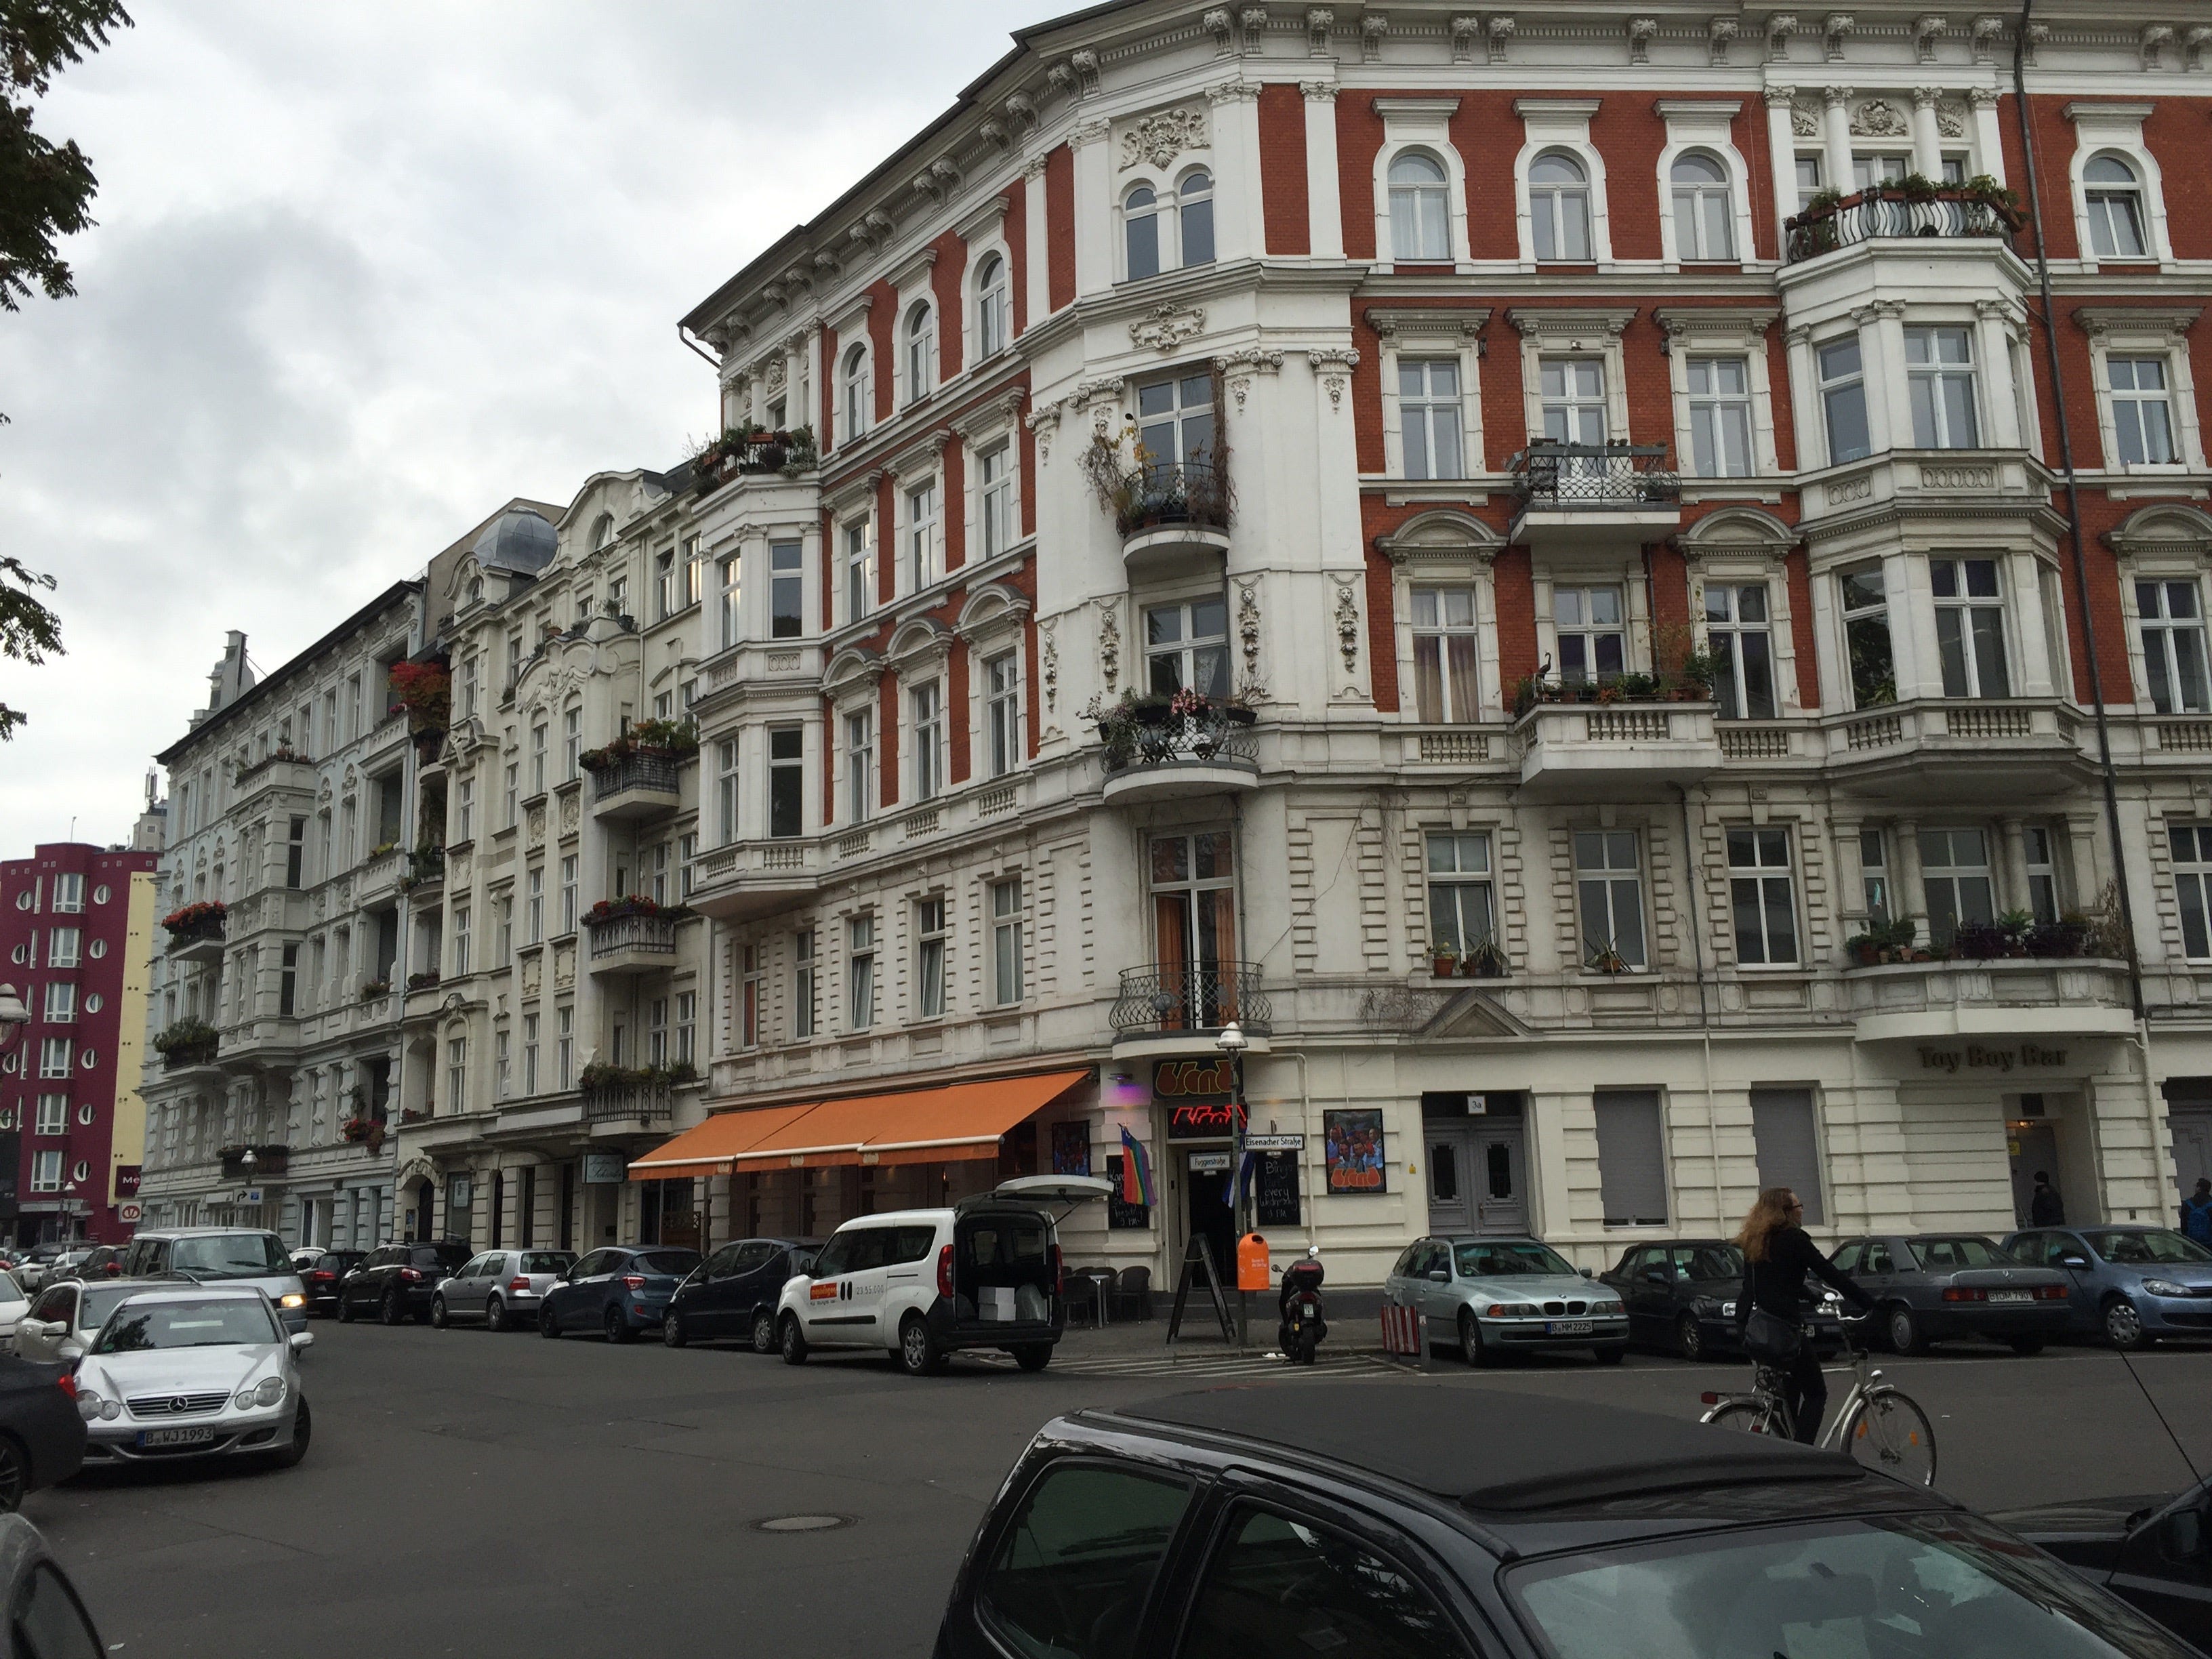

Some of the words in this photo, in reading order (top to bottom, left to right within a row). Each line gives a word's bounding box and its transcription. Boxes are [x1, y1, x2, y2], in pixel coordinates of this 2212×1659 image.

[1918, 1046, 1961, 1073] Toy
[1968, 1045, 2016, 1073] Boy
[2021, 1044, 2066, 1067] Bar
[1246, 1138, 1279, 1146] Eisenacher
[1281, 1137, 1301, 1147] Straße
[1195, 1157, 1226, 1166] Fuggerstraße
[1265, 1188, 1289, 1201] every
